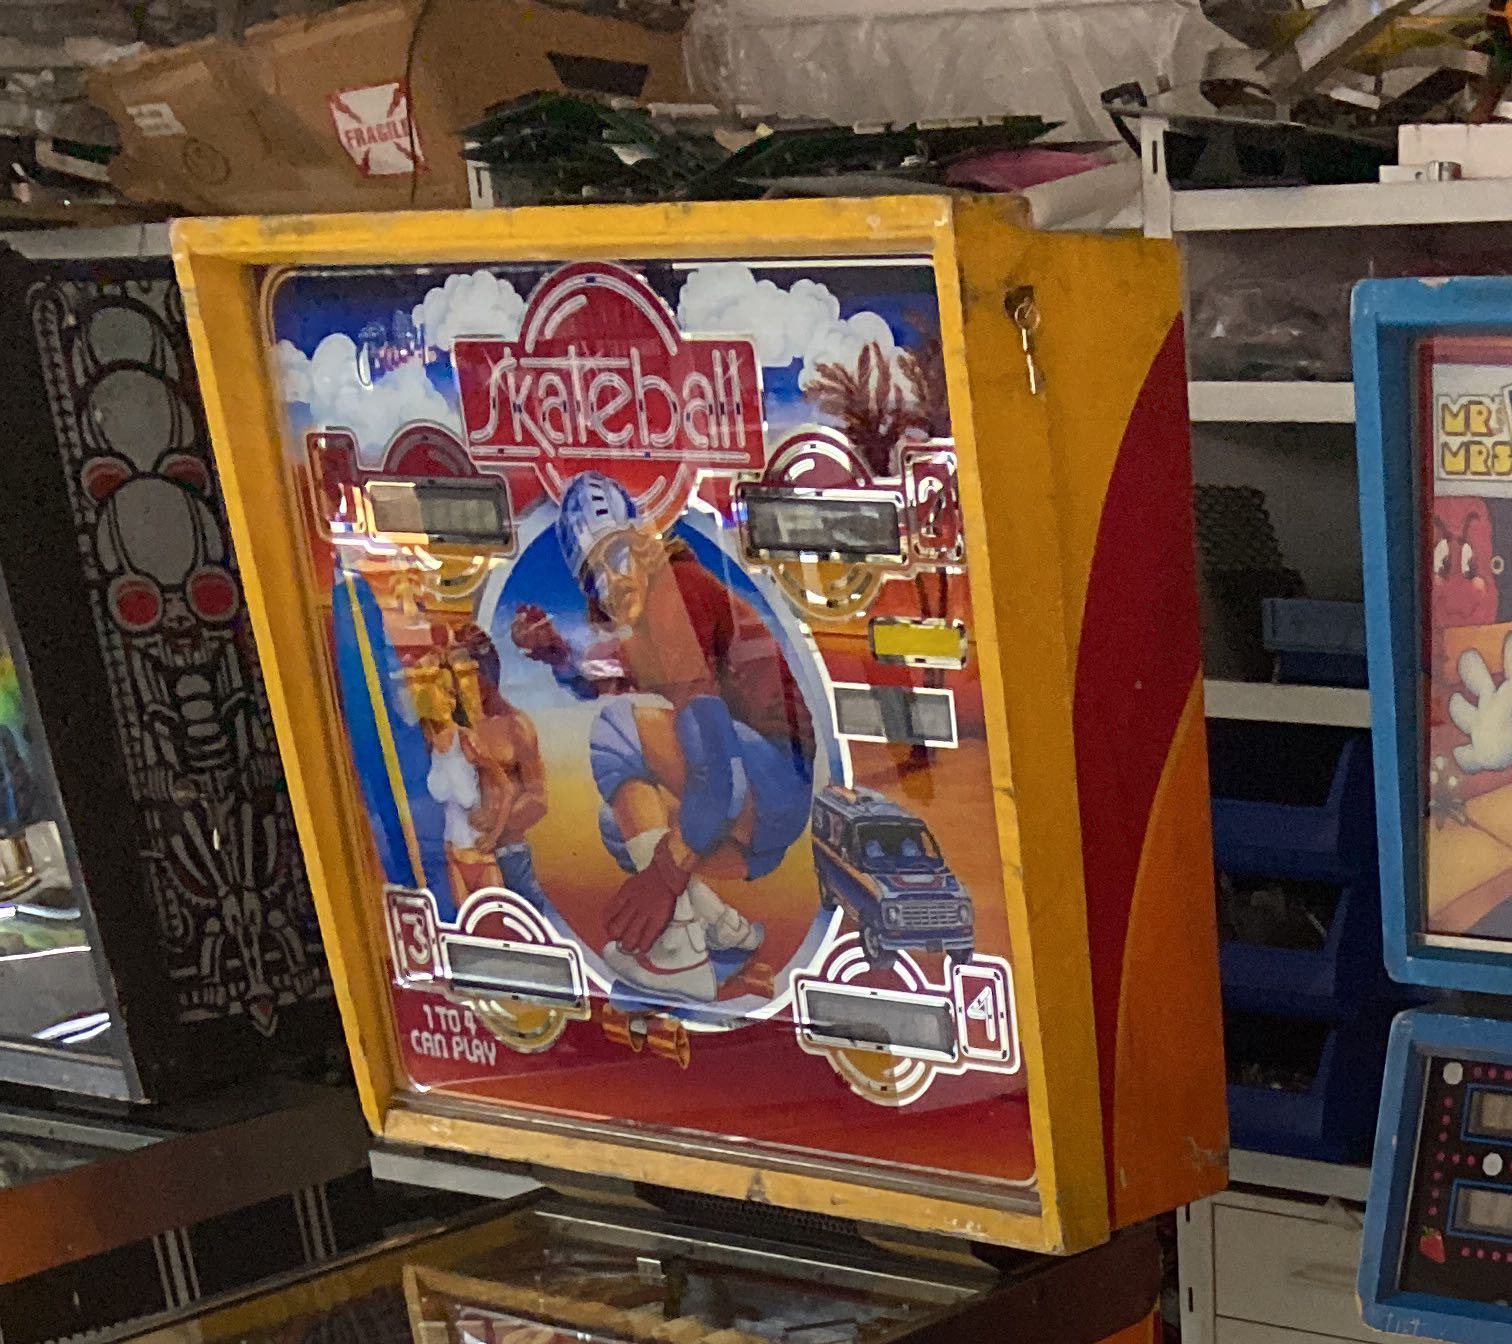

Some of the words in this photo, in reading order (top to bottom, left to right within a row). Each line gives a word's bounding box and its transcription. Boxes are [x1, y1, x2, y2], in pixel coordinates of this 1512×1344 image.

[401, 912, 430, 965] 3
[422, 1004, 434, 1030] 1
[437, 1007, 462, 1032] TO
[463, 1010, 478, 1037] 4
[966, 985, 997, 1042] 4
[410, 1028, 449, 1059] CAN
[452, 1035, 498, 1067] PLAY
